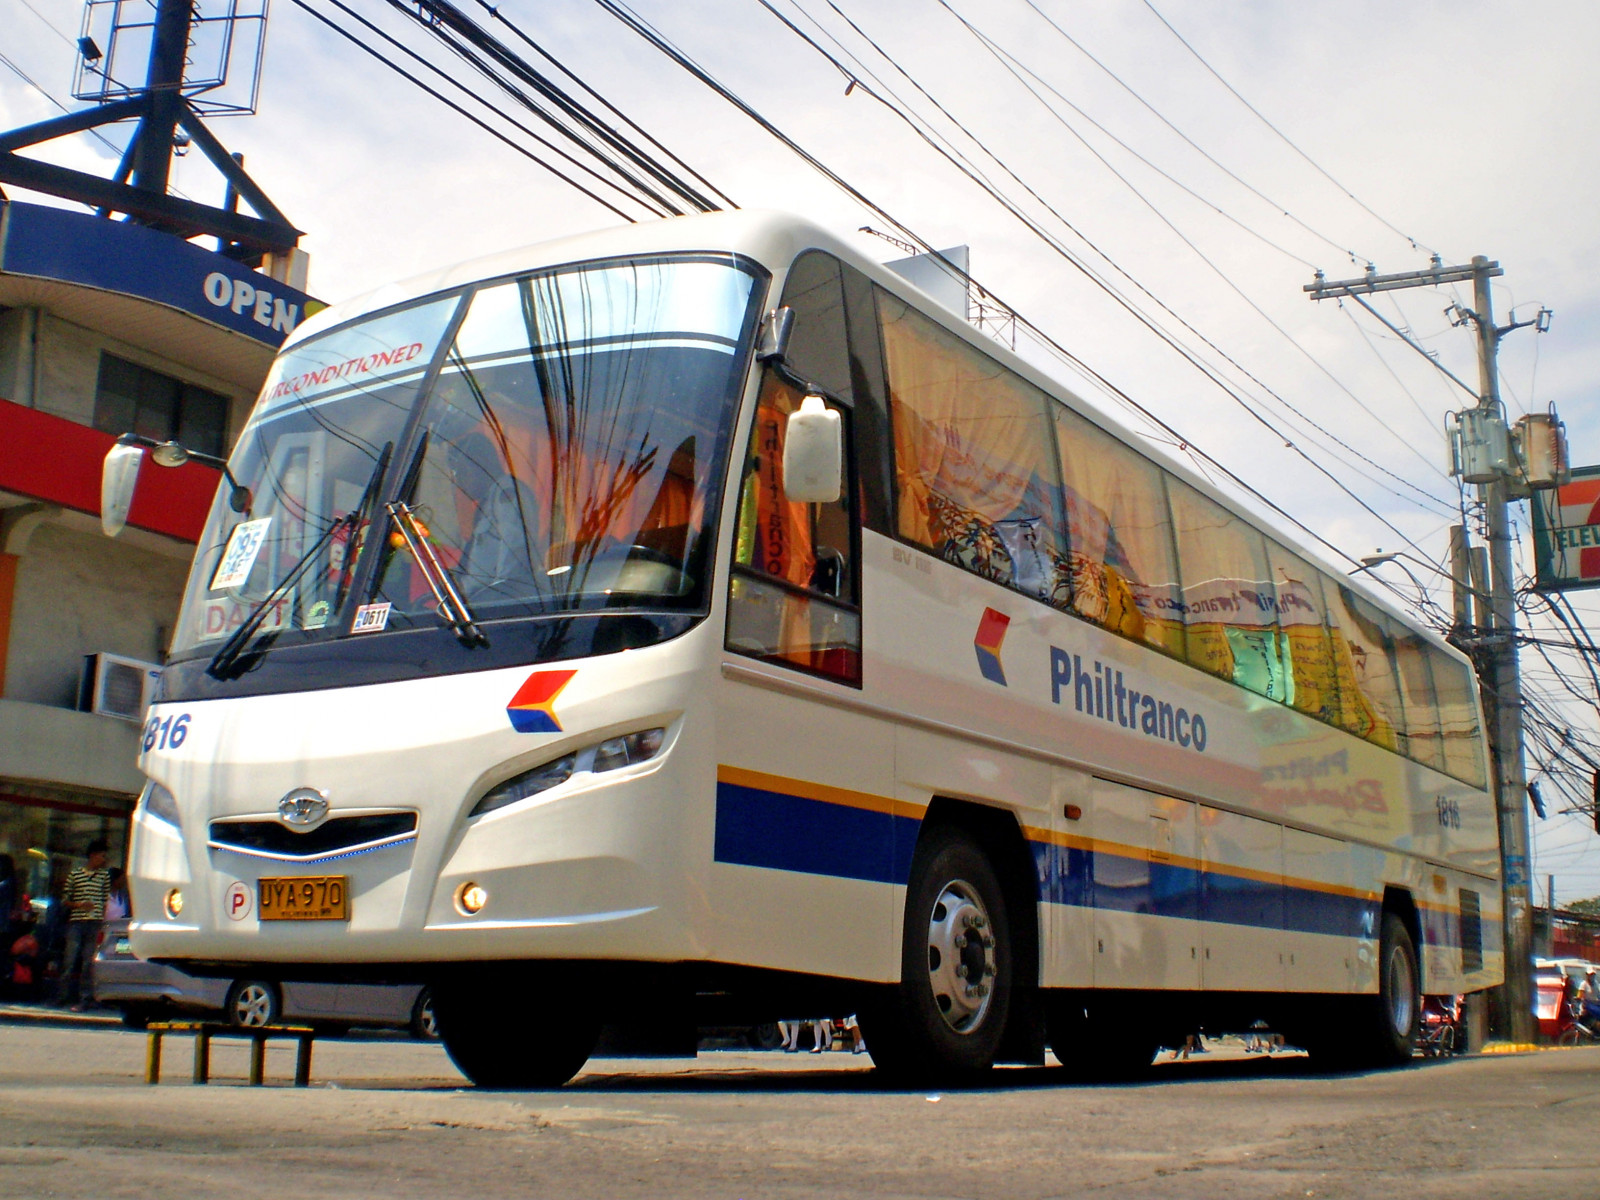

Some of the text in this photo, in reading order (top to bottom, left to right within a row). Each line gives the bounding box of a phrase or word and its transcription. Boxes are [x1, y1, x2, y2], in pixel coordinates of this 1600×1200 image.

[204, 272, 298, 335] OPEN
[260, 342, 423, 405] AIRCONDITIONED
[363, 609, 387, 626] 0611
[1050, 645, 1206, 752] Philtranco
[1436, 795, 1461, 830] 1816
[232, 893, 245, 914] P
